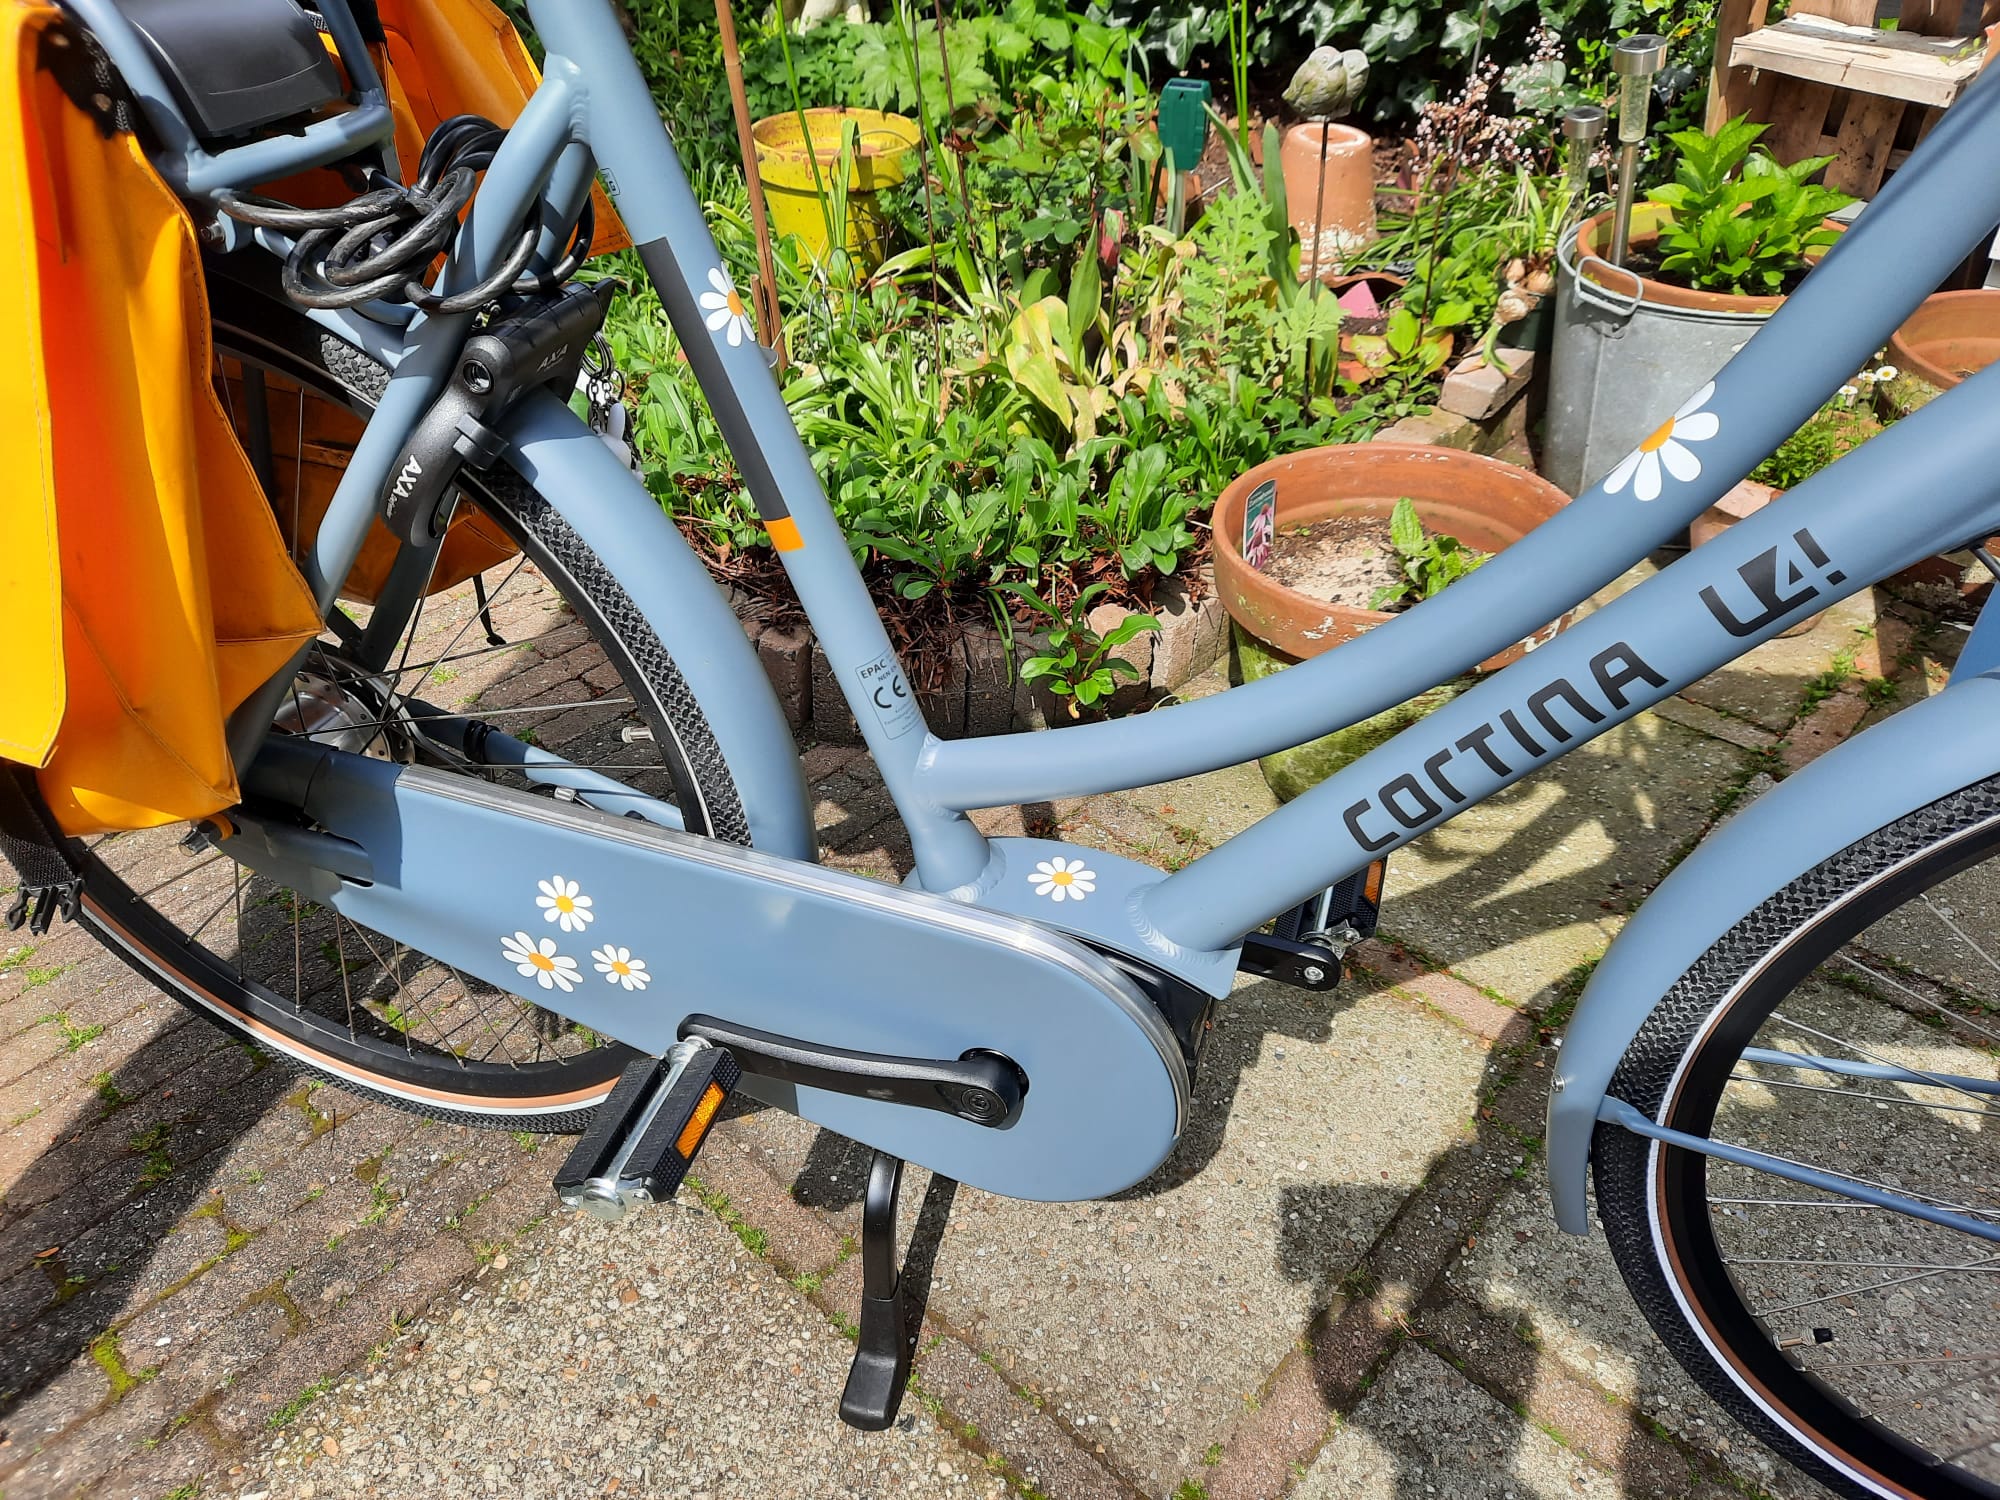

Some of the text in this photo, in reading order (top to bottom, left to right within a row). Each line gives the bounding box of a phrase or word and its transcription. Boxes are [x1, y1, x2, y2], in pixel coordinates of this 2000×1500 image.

[393, 454, 423, 498] AXA
[860, 659, 887, 679] EPAC
[874, 675, 906, 709] CE
[1343, 641, 1670, 852] CORTINA
